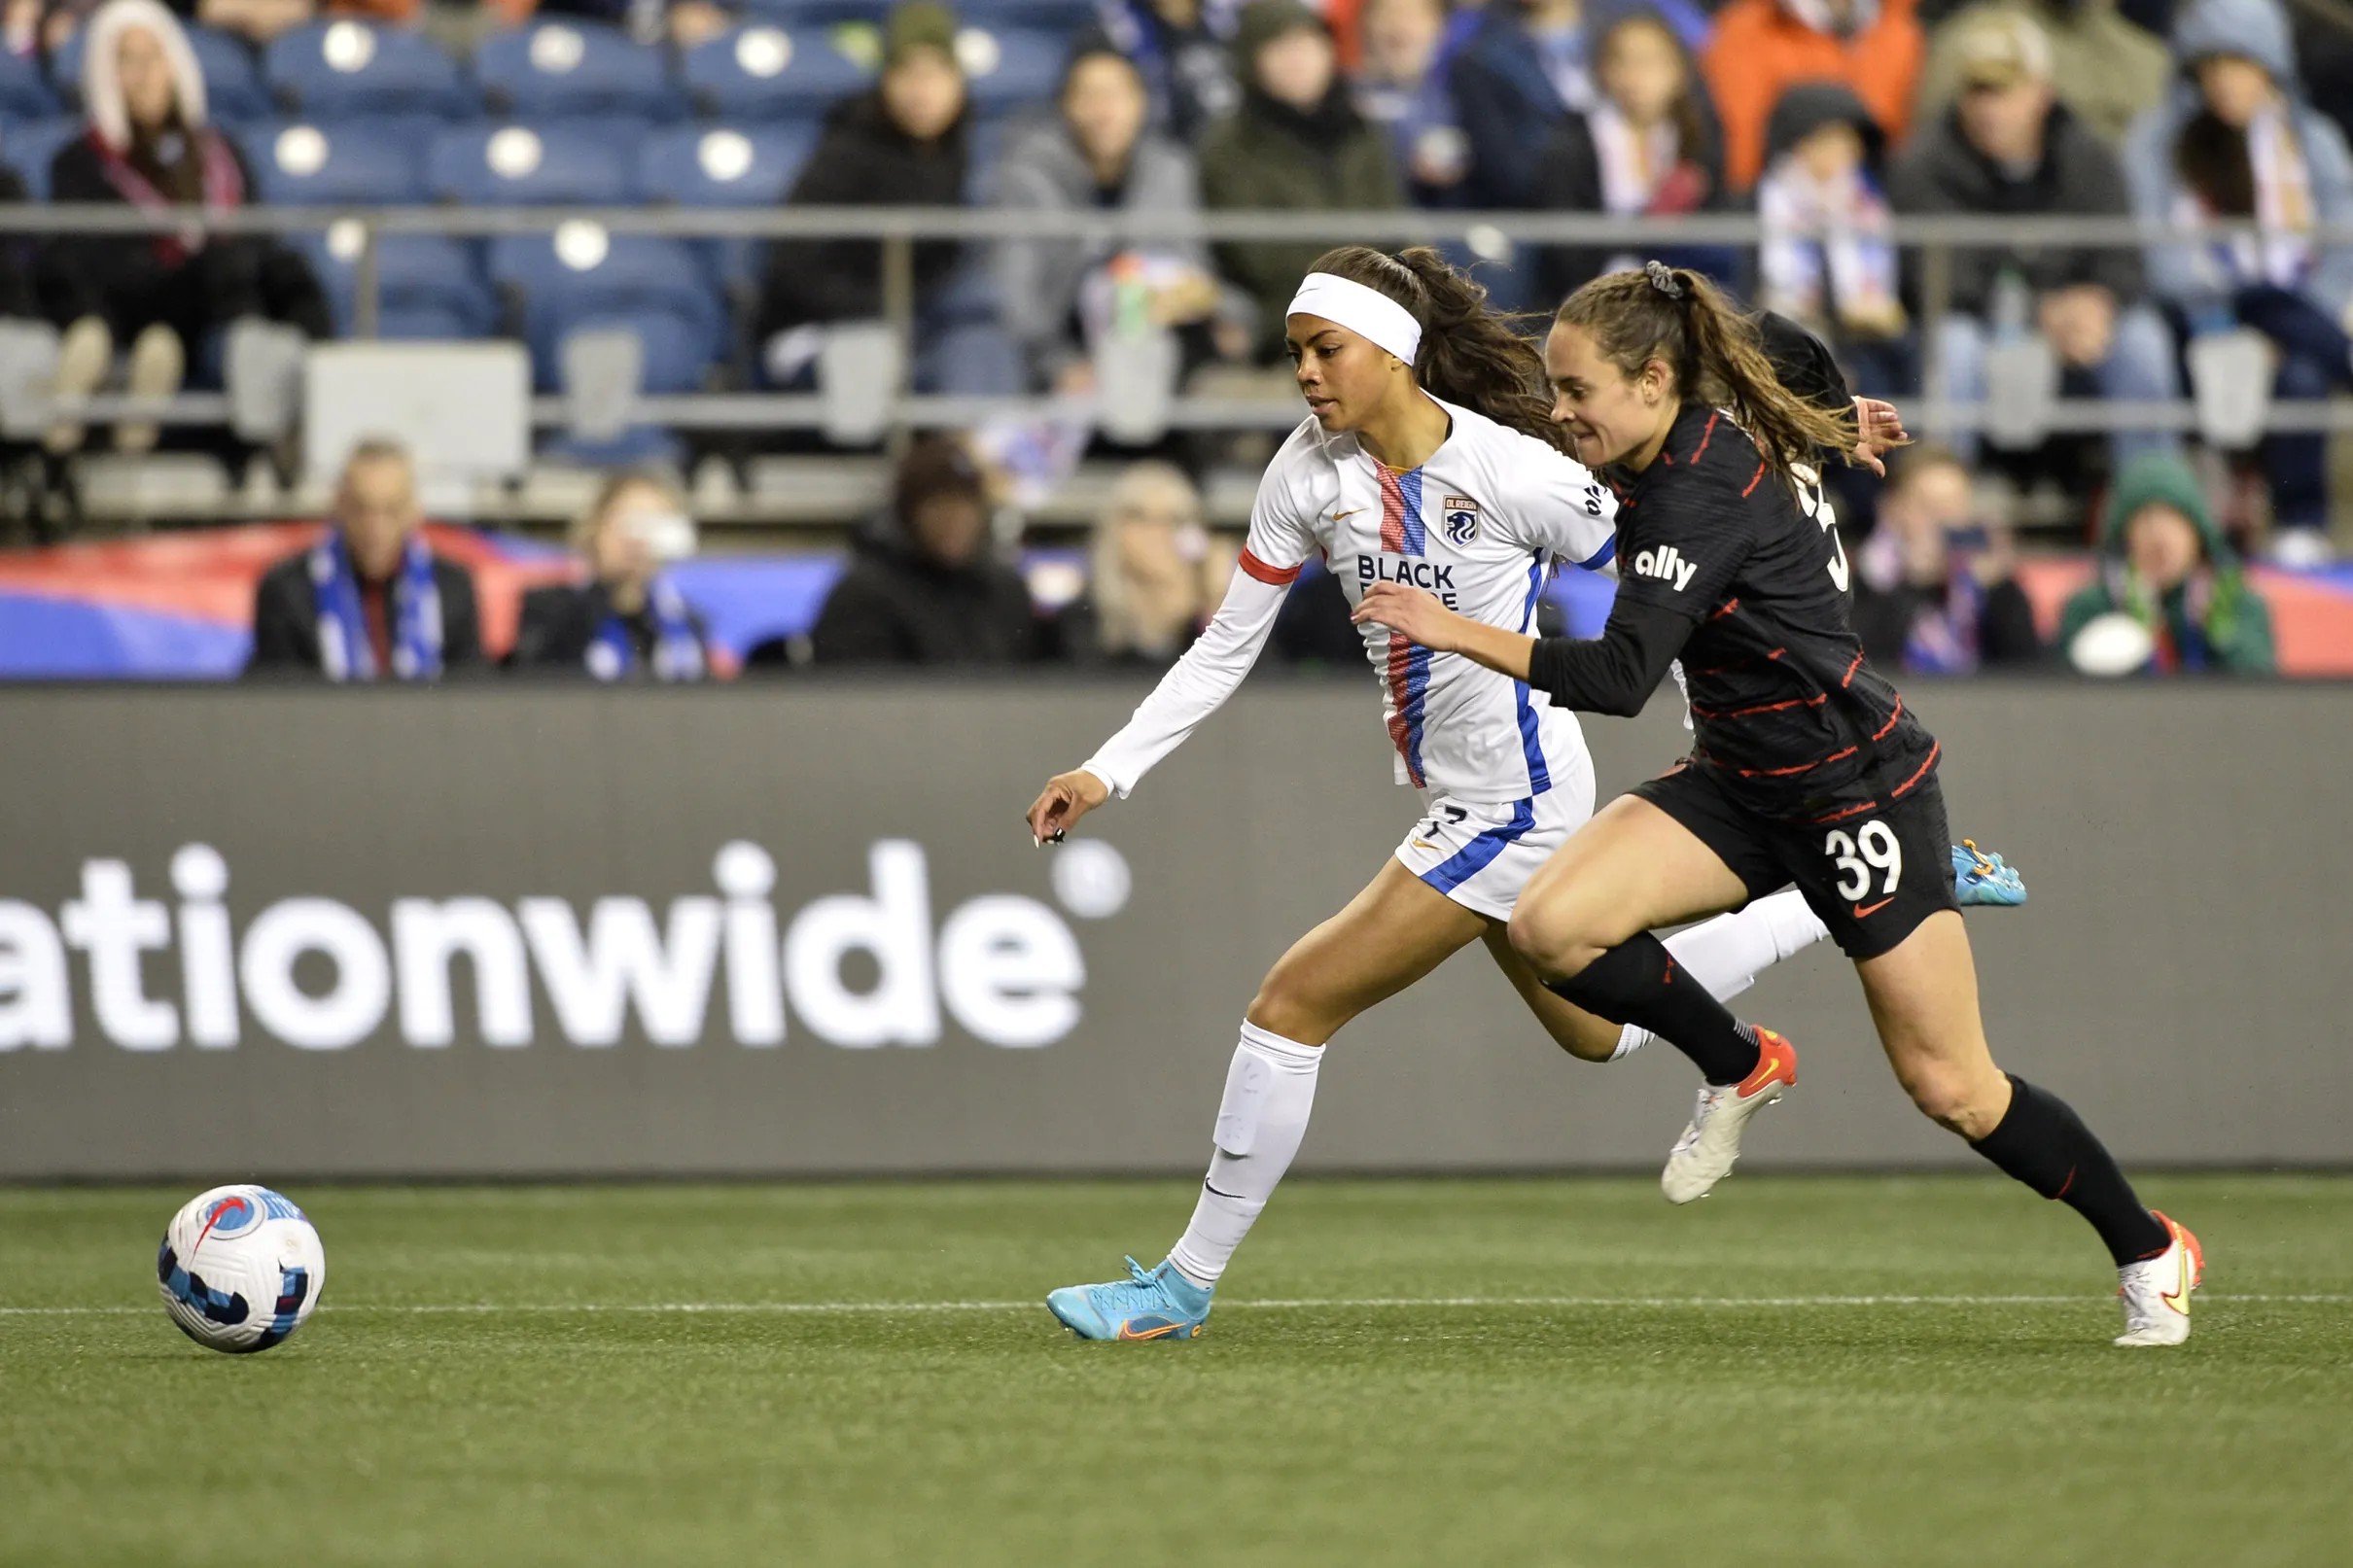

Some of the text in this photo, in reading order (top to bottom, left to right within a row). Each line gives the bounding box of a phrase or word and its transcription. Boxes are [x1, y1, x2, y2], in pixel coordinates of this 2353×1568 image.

[1357, 554, 1456, 589] BLACK
[1634, 544, 1698, 592] ally
[1825, 819, 1902, 901] 39
